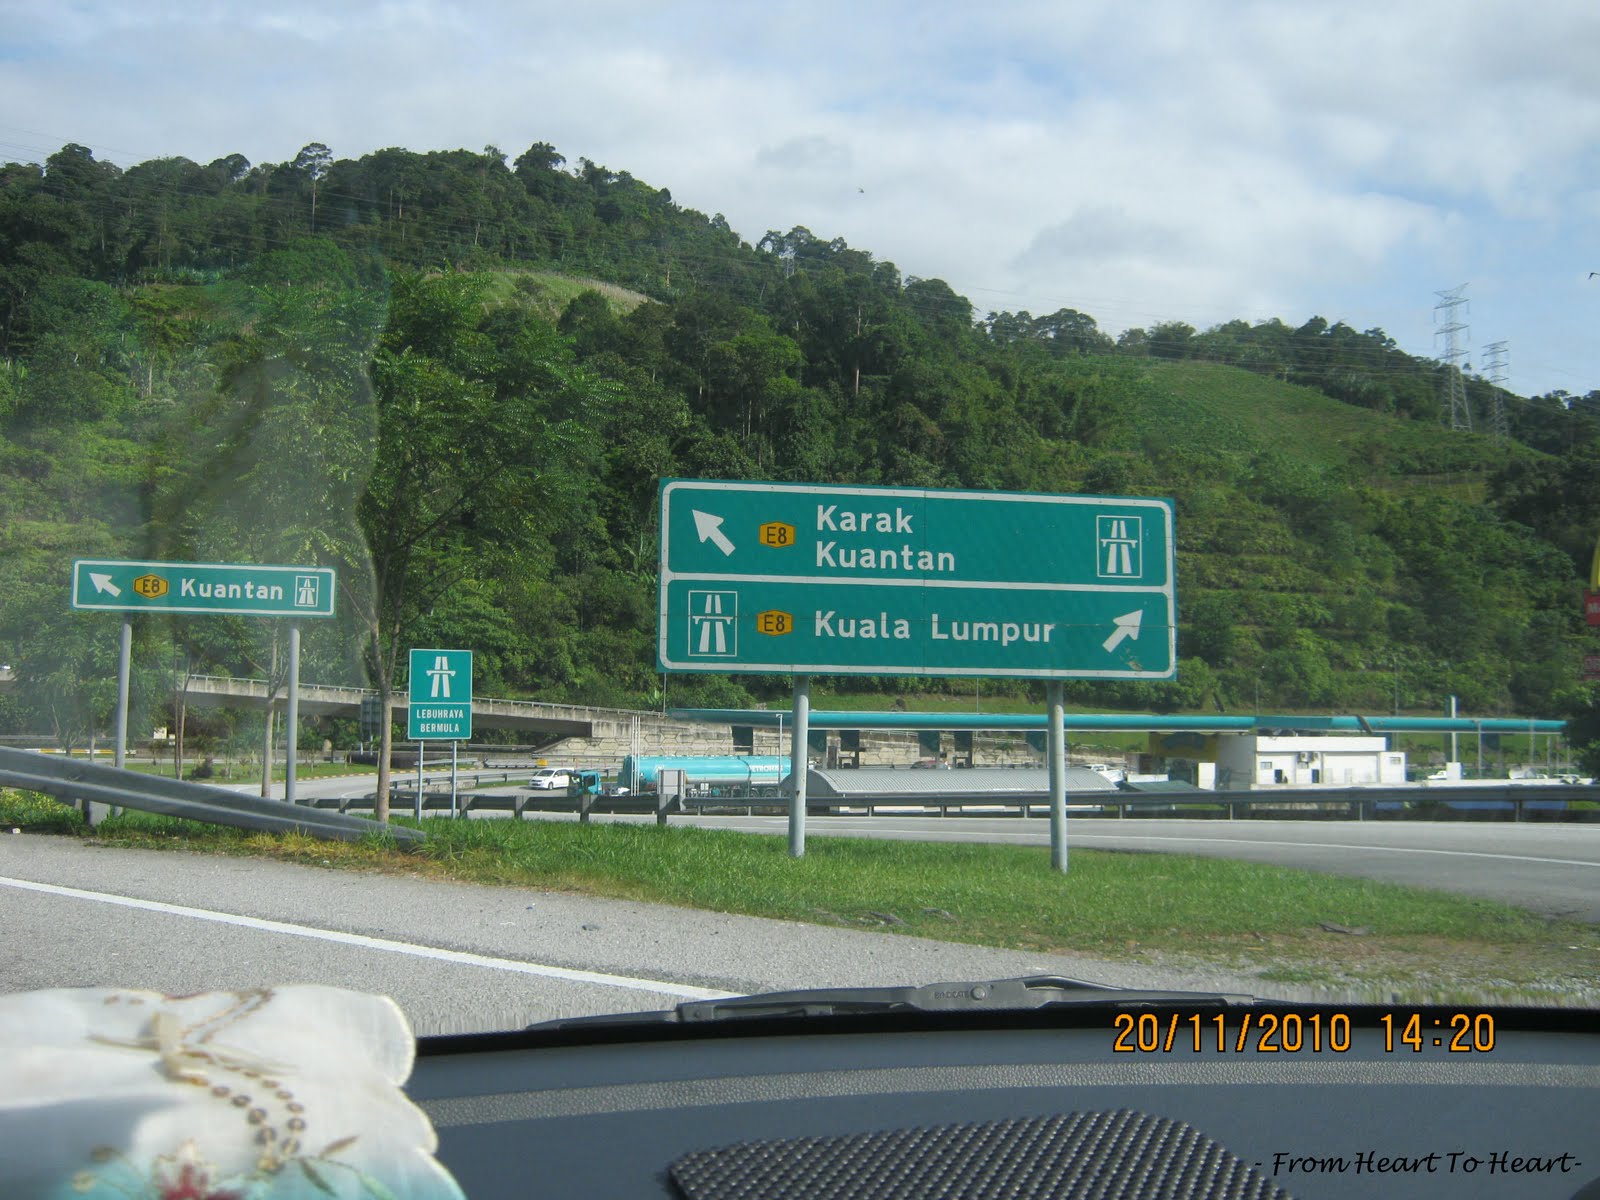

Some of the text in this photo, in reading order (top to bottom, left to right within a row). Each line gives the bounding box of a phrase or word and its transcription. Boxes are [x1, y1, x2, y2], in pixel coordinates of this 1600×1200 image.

[816, 504, 914, 534] Karak
[766, 526, 787, 545] E8
[816, 540, 956, 572] Kuantan
[142, 578, 284, 600] E8 Kuantan
[763, 610, 1056, 647] E8 Kuala Lumpur
[416, 709, 464, 719] LEBUHRAYA
[420, 723, 460, 733] BERMULA
